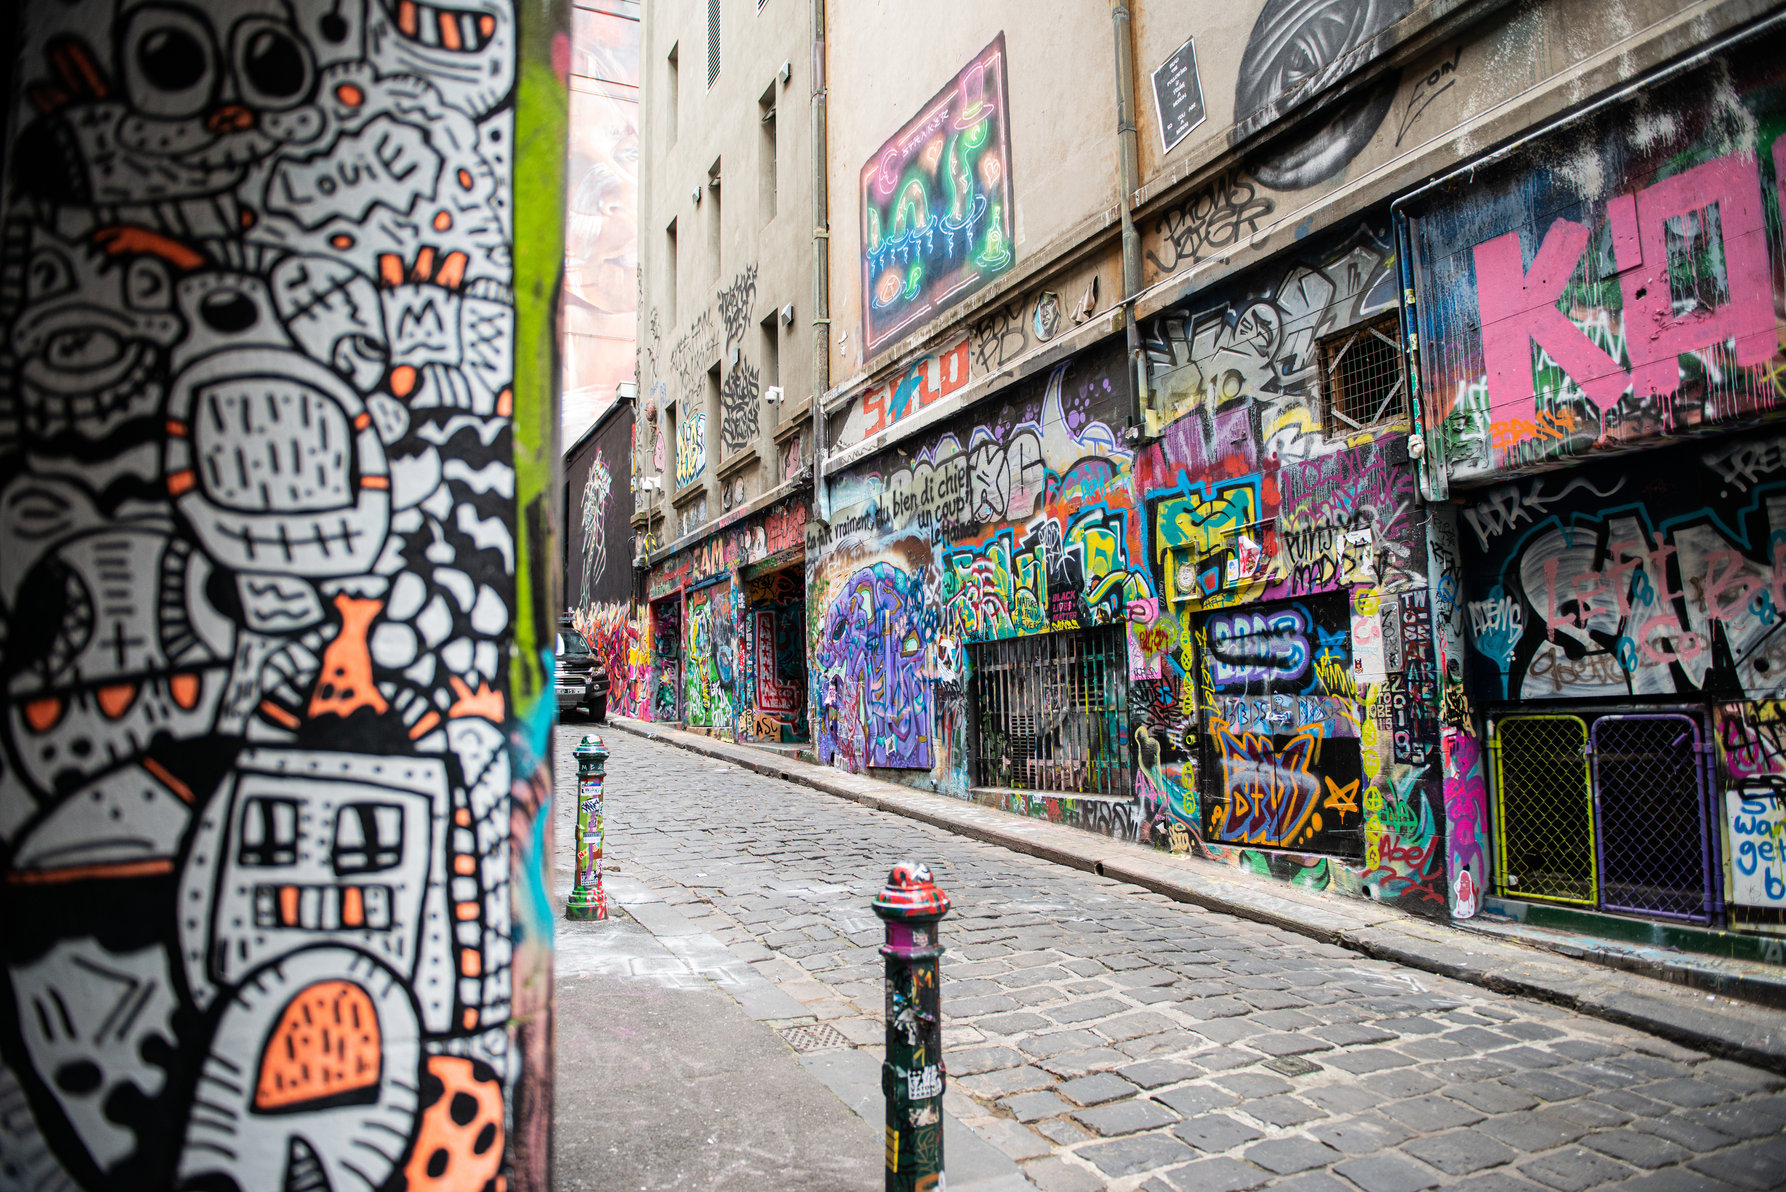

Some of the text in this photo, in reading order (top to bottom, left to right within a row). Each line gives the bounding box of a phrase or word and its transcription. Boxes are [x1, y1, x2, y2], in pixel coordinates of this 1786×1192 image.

[901, 108, 950, 159] STRAKER
[892, 489, 917, 519] bien
[917, 496, 966, 529] un coup
[1052, 590, 1077, 602] BLACK
[1052, 611, 1078, 622] MATTER
